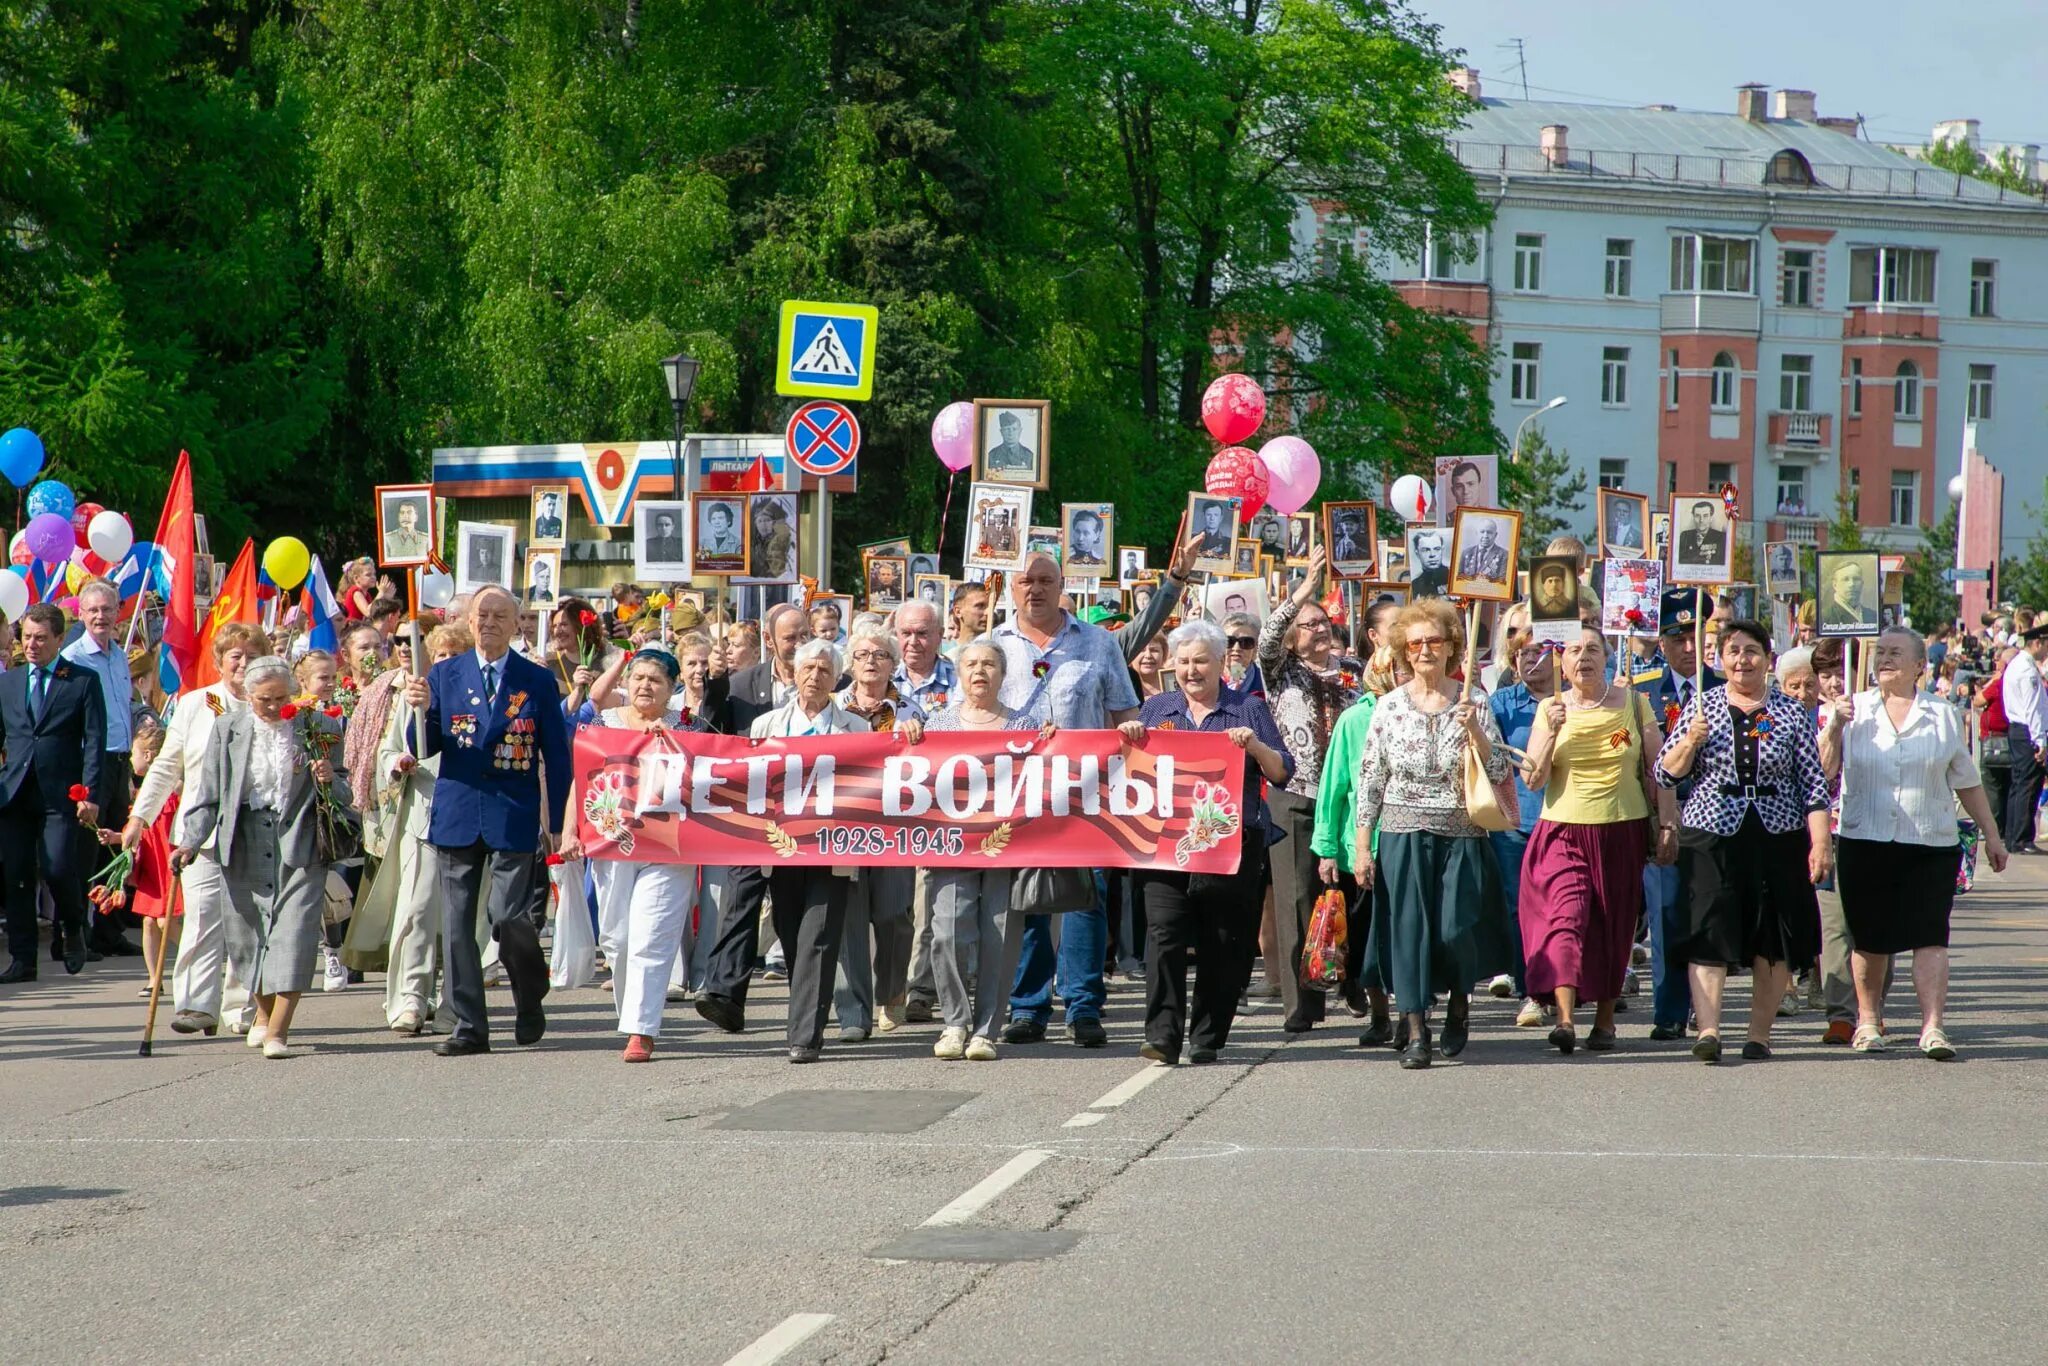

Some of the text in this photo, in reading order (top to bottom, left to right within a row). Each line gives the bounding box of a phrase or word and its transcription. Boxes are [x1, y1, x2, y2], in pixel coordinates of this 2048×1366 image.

[712, 462, 754, 472] ЛЫТКАР
[634, 740, 1175, 821] ДЕТИ ВОЙНЫ
[815, 825, 965, 856] 1928-1945
